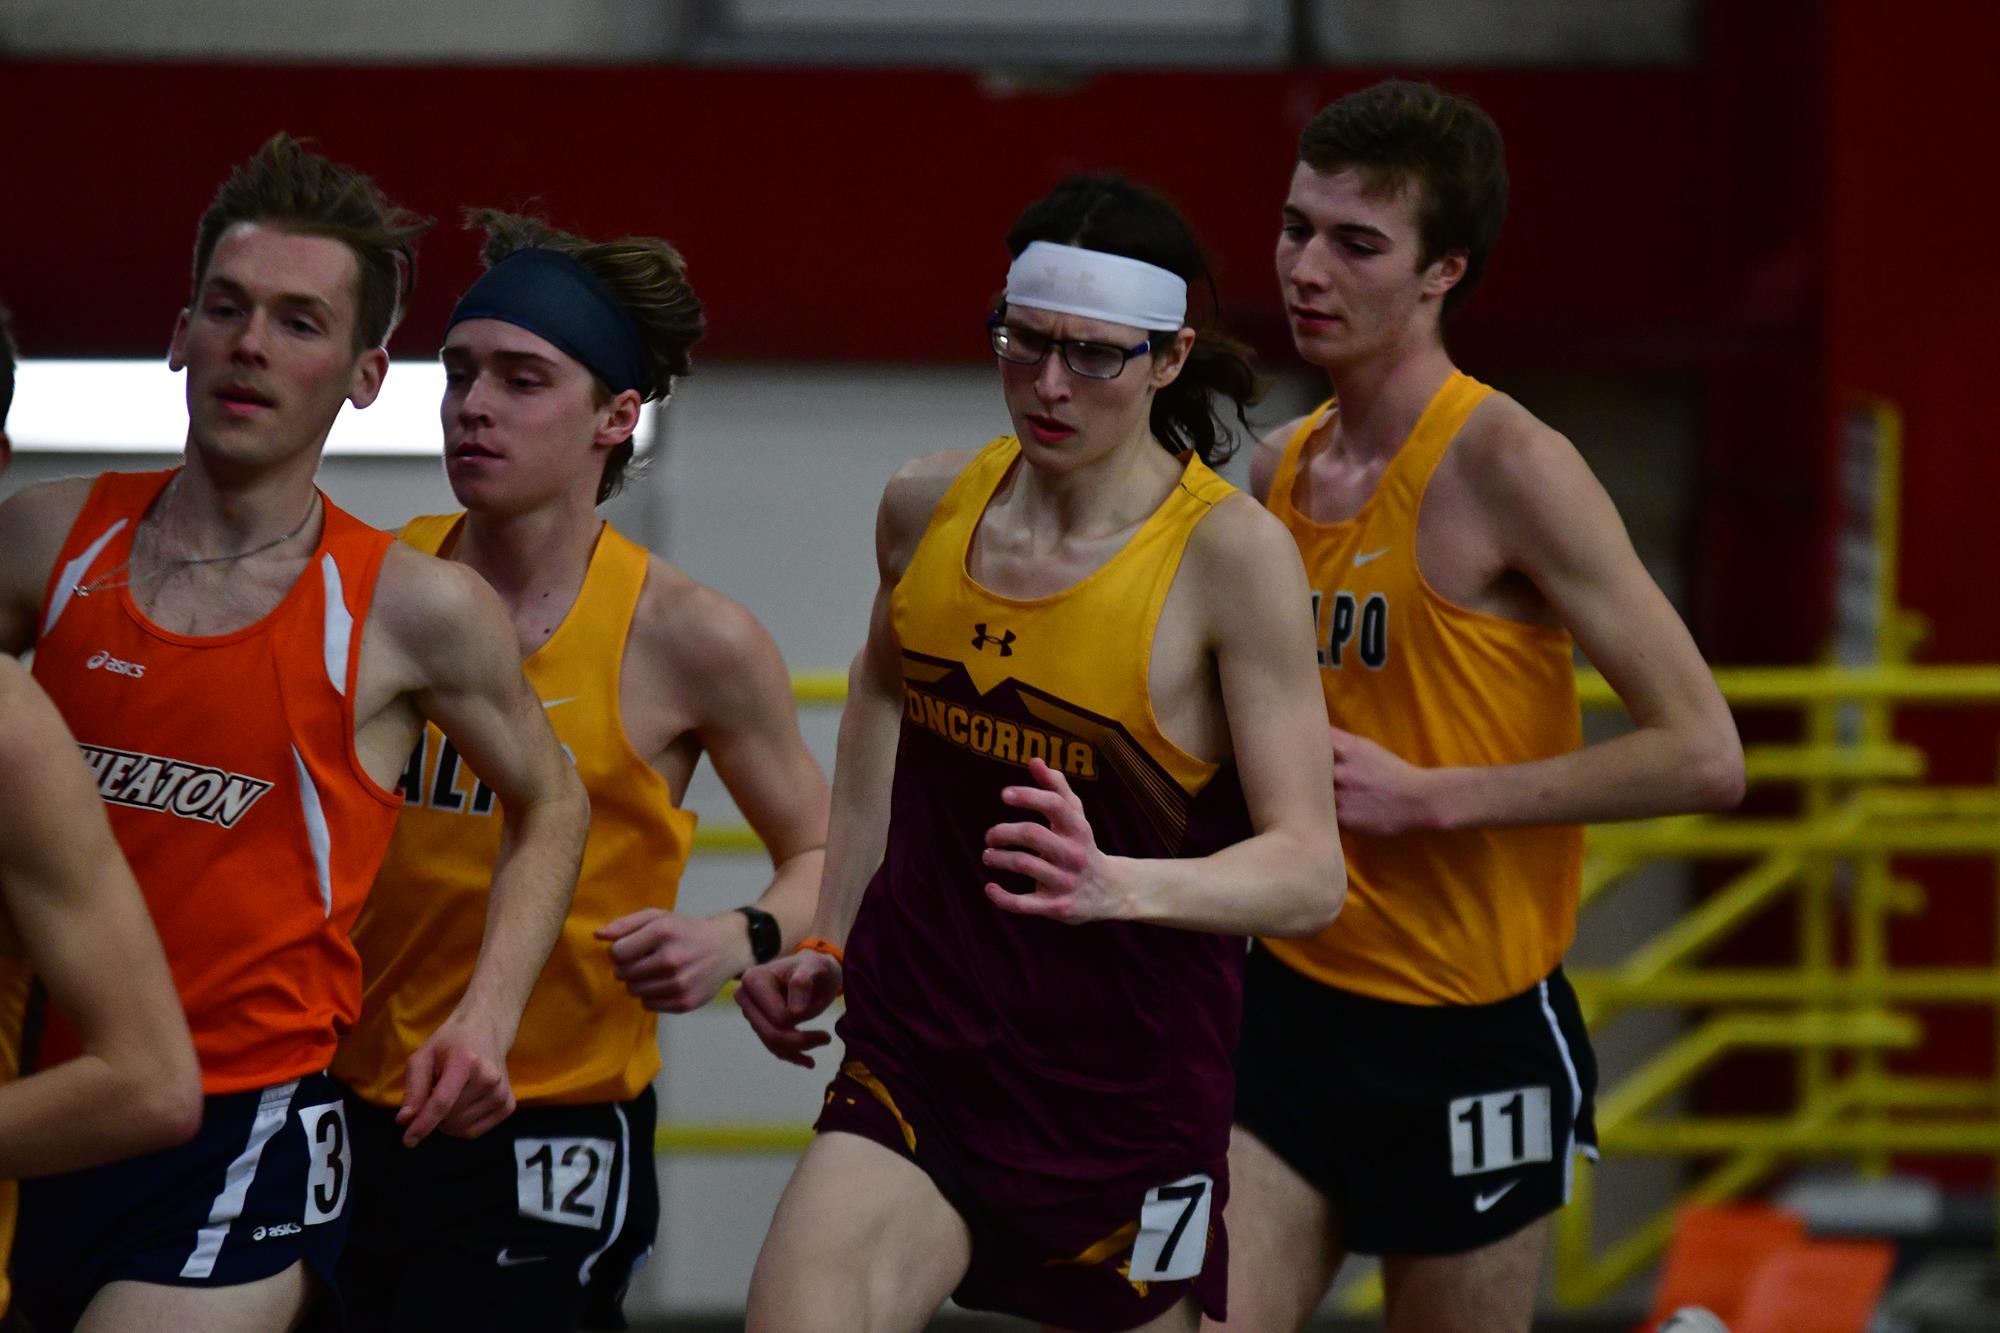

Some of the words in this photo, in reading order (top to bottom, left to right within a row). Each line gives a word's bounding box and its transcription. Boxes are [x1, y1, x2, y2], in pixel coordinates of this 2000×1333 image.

[1311, 591, 1389, 672] PO
[902, 680, 1098, 780] ONCORDIA
[314, 1110, 344, 1214] 3
[1458, 1094, 1525, 1168] 11
[525, 1144, 600, 1218] 12
[1155, 1183, 1206, 1272] 7
